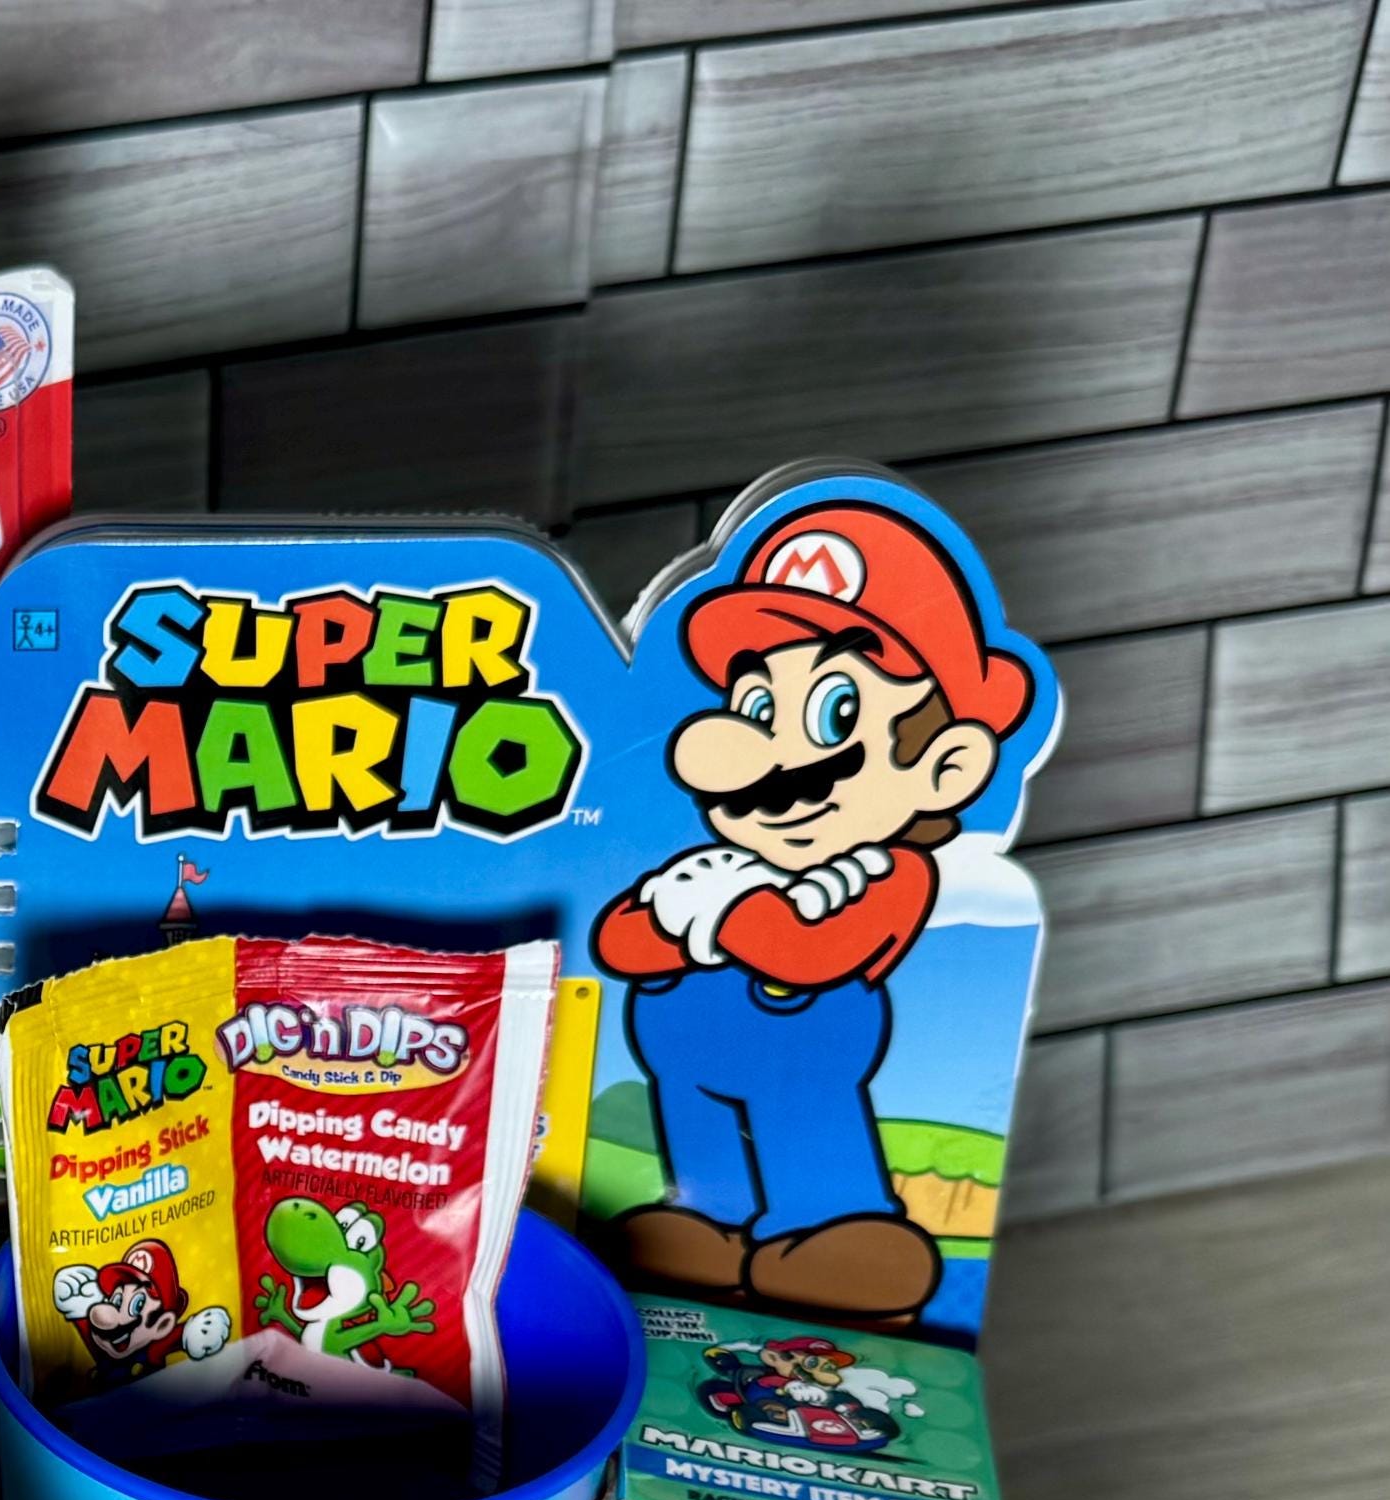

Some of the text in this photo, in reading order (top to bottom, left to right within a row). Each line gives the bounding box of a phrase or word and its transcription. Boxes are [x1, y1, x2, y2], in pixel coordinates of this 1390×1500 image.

[1, 299, 40, 332] MADE
[8, 376, 35, 401] USA
[34, 622, 56, 637] 4+
[110, 583, 528, 691] SUPER
[42, 692, 578, 824] MARIO
[67, 1020, 189, 1085] SUPER
[219, 1004, 303, 1070] DIG
[347, 1007, 467, 1071] DIPS
[47, 1054, 207, 1135] MARIO
[282, 1066, 402, 1085] Candy Stick & Dip
[50, 1115, 210, 1183] Dipping Stick
[248, 1100, 467, 1151] Dipping Candy
[257, 1135, 451, 1186] Watermelon
[84, 1165, 188, 1220] Vanilla
[261, 1168, 449, 1211] ARTIFICIALLY FLAVORED
[49, 1190, 215, 1247] ARTIFICIALLY FLAVORED
[665, 1458, 802, 1500] MYSTERY
